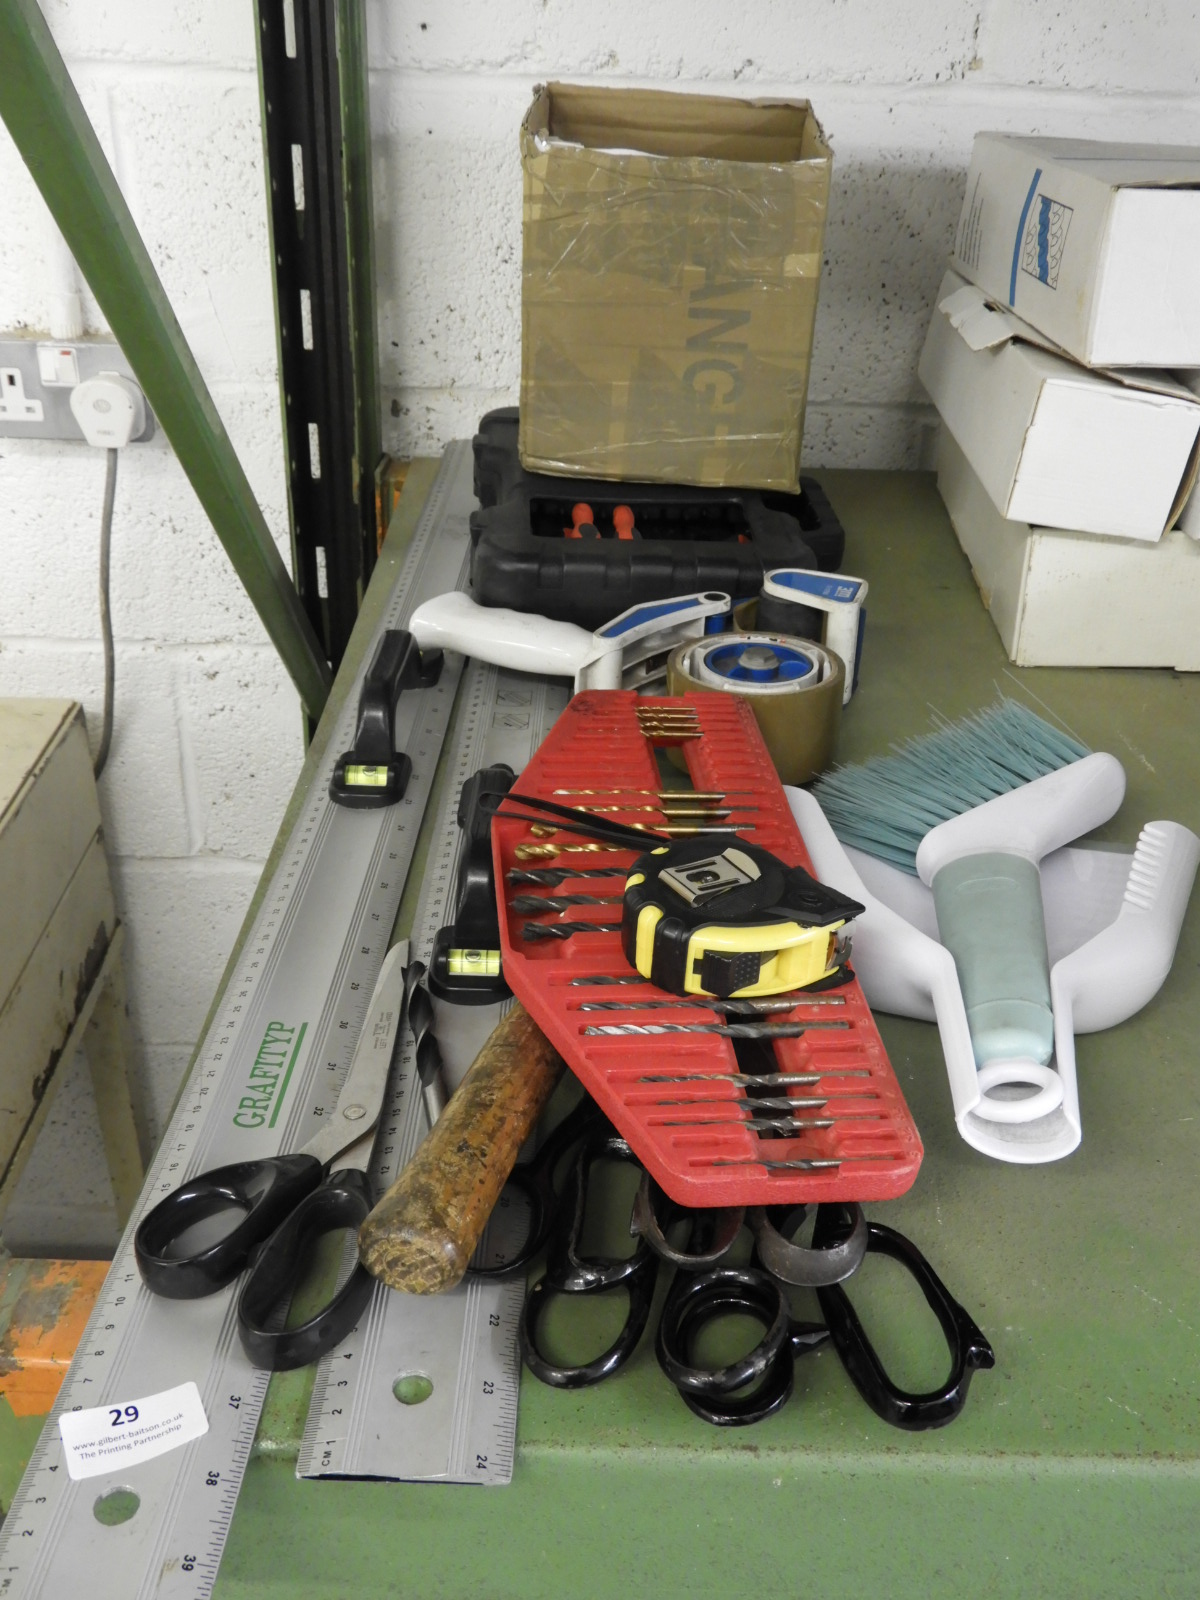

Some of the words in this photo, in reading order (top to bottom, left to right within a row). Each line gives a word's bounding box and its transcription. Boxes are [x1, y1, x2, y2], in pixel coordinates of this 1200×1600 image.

[339, 1020, 349, 1030] 30
[326, 1062, 337, 1072] 31
[232, 1021, 295, 1129] GRAFITYP
[313, 1106, 324, 1117] 32
[184, 1123, 195, 1132] 18
[177, 1143, 187, 1152] 17
[385, 1146, 394, 1155] 13
[169, 1162, 179, 1172] 16
[380, 1165, 390, 1175] 12
[161, 1183, 171, 1192] 15
[124, 1273, 135, 1282] 11
[115, 1296, 126, 1307] 10
[489, 1313, 500, 1327] 22
[482, 1380, 494, 1395] 23
[228, 1394, 241, 1410] 37
[108, 1405, 140, 1427] 29
[72, 1412, 184, 1451] www.gilbert-baitson.co.uk
[79, 1451, 97, 1461] The
[98, 1443, 133, 1457] Printing
[133, 1423, 182, 1446] Partnership
[321, 1450, 332, 1467] CM
[475, 1454, 488, 1470] 24
[49, 1465, 59, 1473] 4
[205, 1470, 220, 1487] 38
[35, 1496, 47, 1504] 3
[21, 1529, 34, 1537] 2
[181, 1554, 196, 1572] 39
